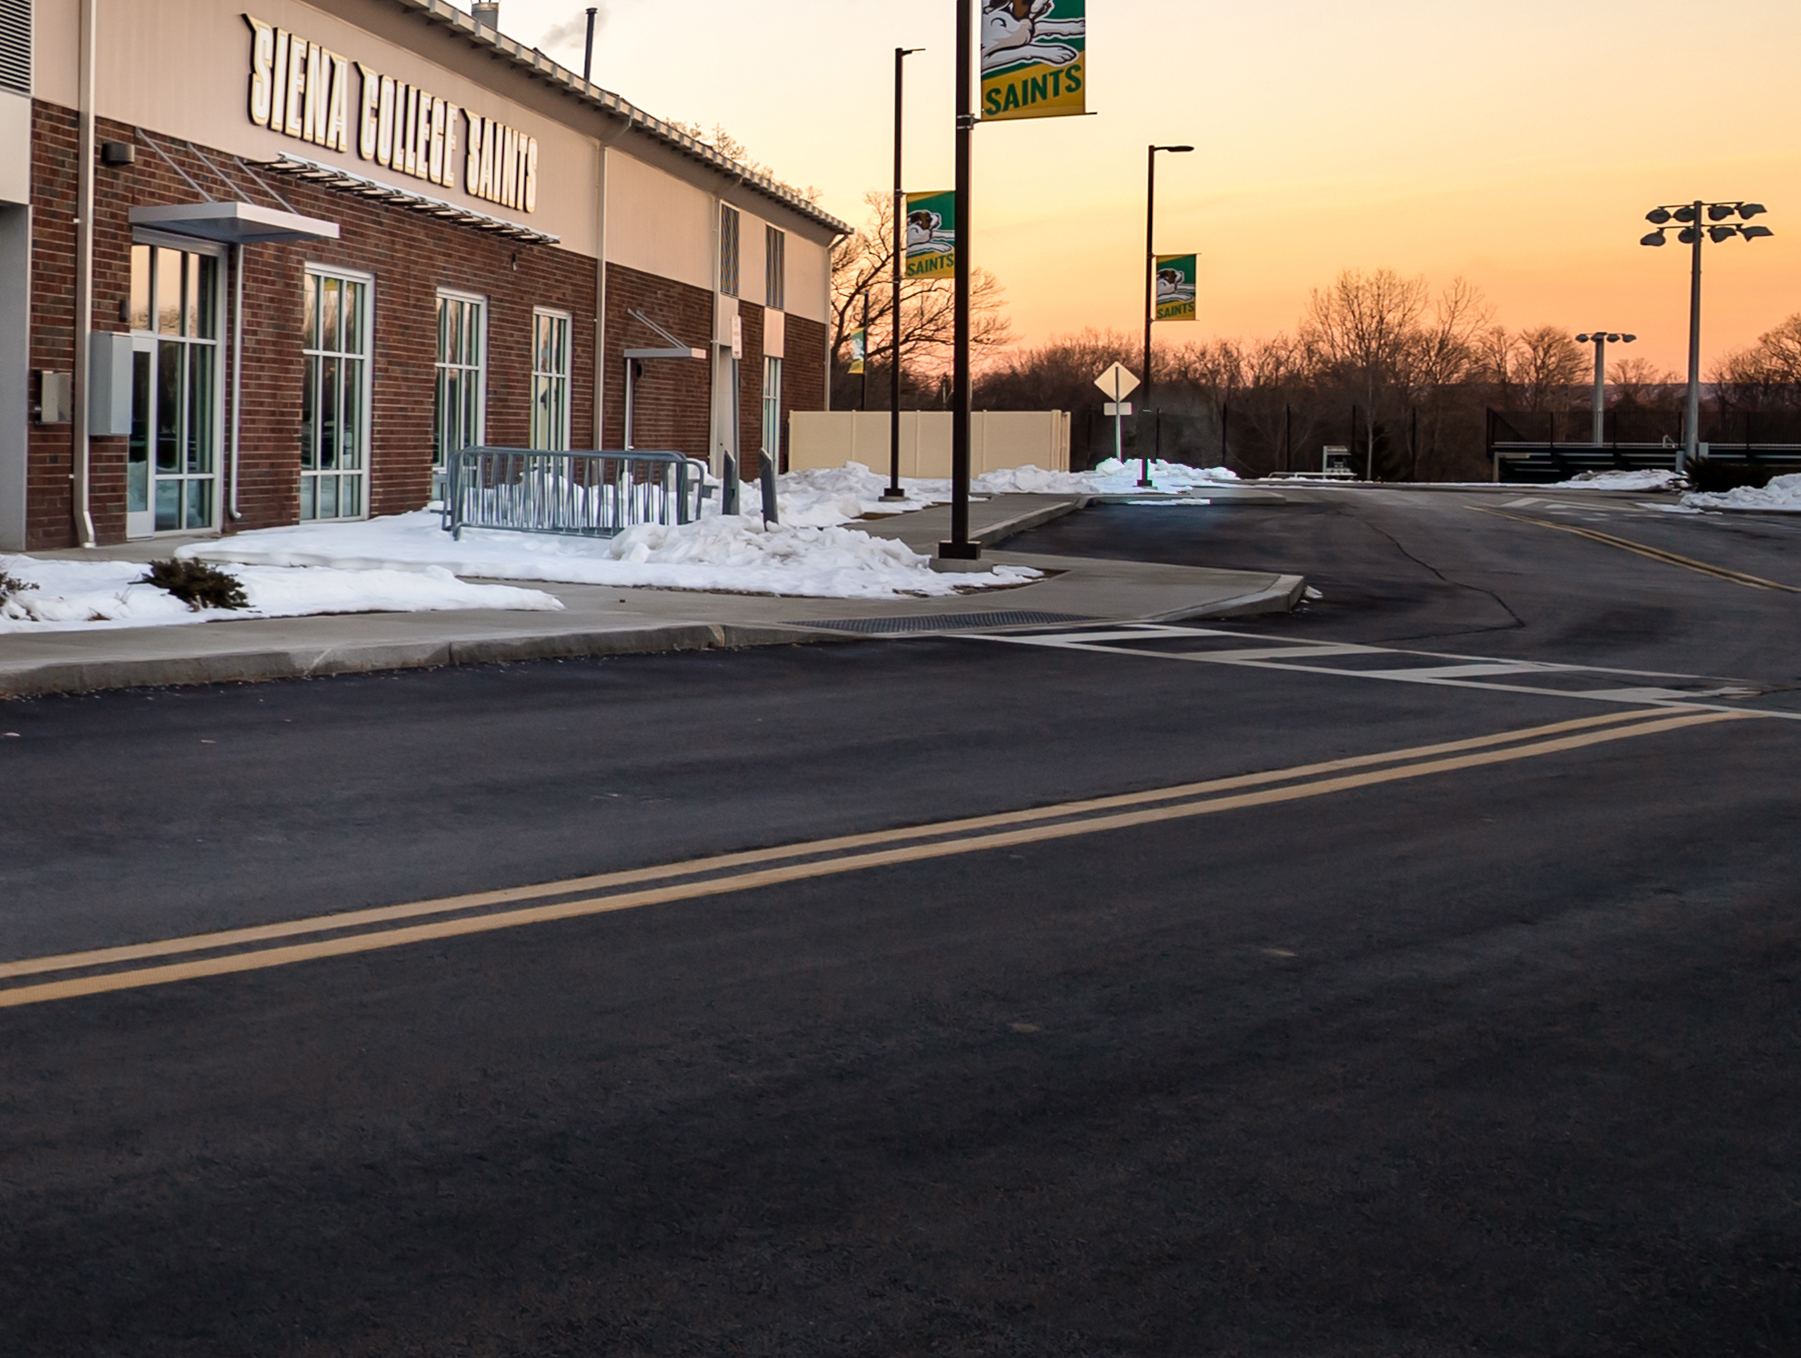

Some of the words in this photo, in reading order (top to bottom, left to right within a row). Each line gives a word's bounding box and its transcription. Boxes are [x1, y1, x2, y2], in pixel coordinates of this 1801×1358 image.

[985, 63, 1082, 116] SAINTS
[242, 13, 348, 153] SIENA
[353, 61, 459, 188] COLLEGE
[461, 107, 538, 213] SAINTS
[907, 252, 954, 276] SAINTS
[1156, 301, 1195, 319] SAINTS
